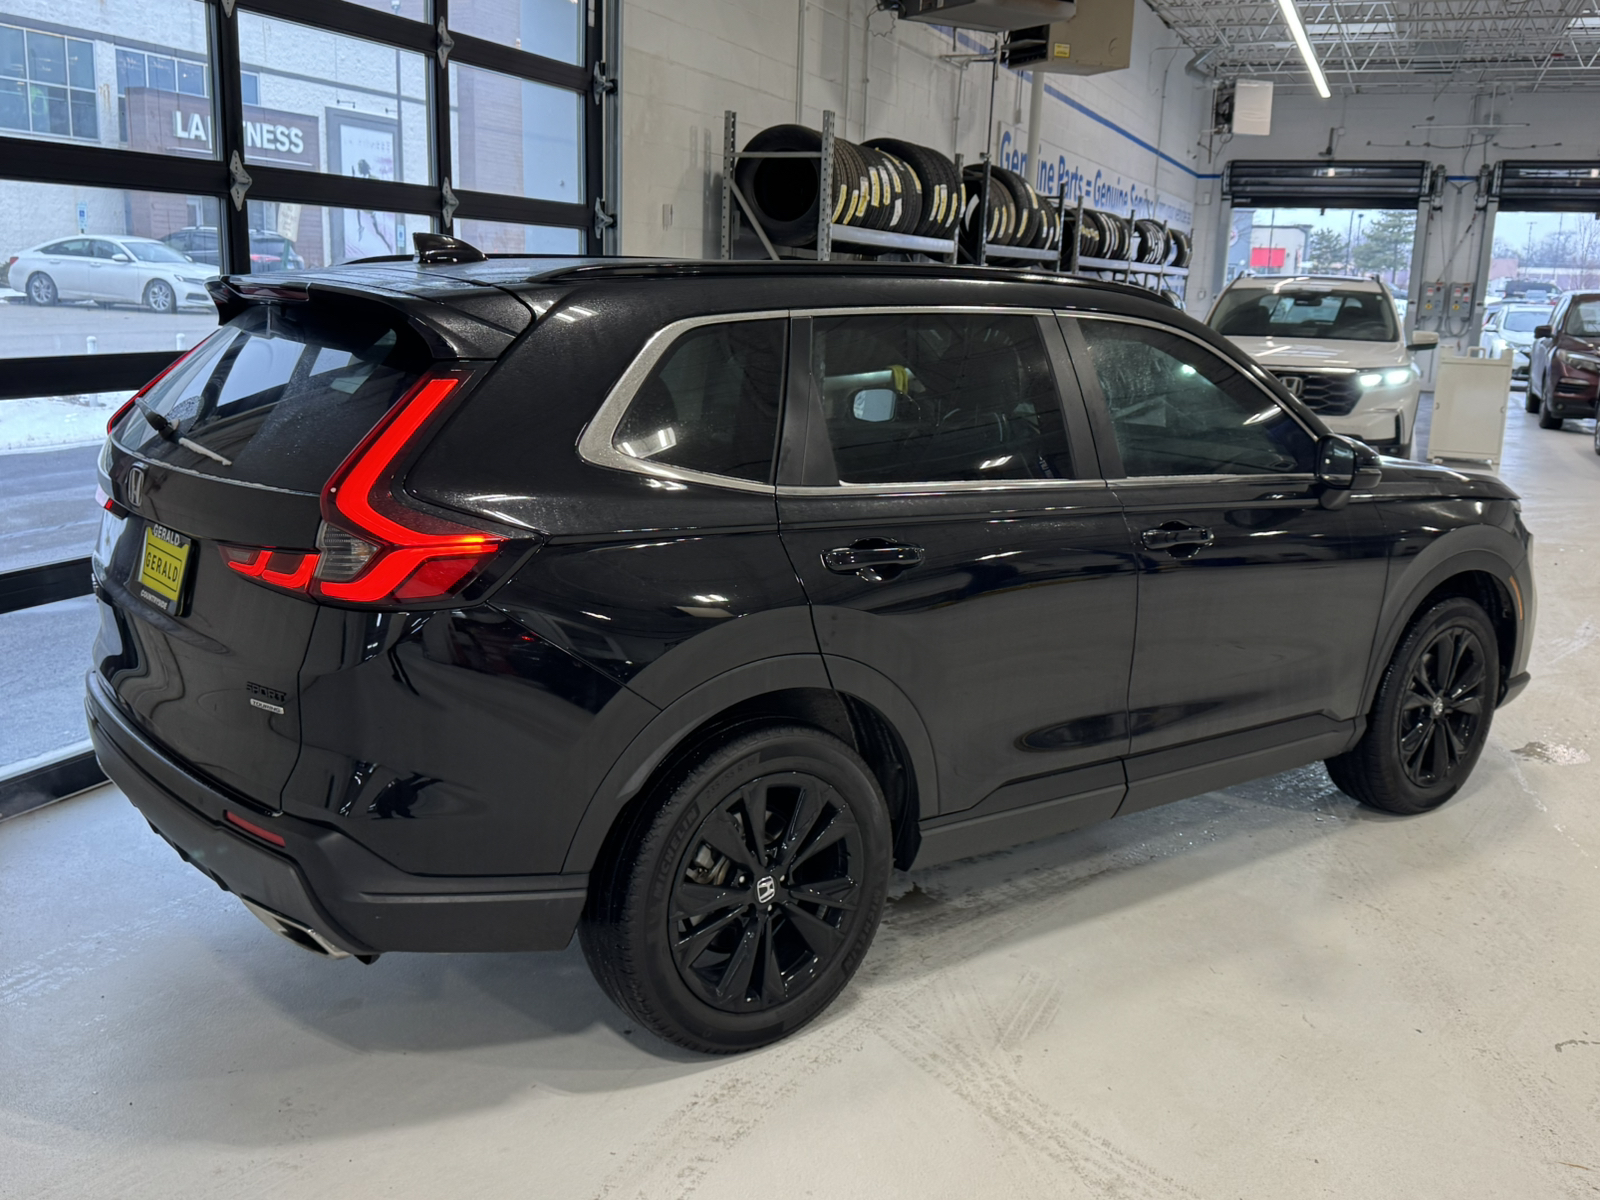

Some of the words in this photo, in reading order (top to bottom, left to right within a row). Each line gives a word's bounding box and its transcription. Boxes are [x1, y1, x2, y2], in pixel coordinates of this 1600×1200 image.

[172, 110, 206, 141] LA
[1001, 131, 1054, 195] Genine
[1094, 169, 1128, 209] Genuine
[153, 524, 180, 546] GERALD
[145, 552, 178, 582] GERALD
[246, 681, 287, 702] SPORT
[653, 807, 699, 899] MICHELIN
